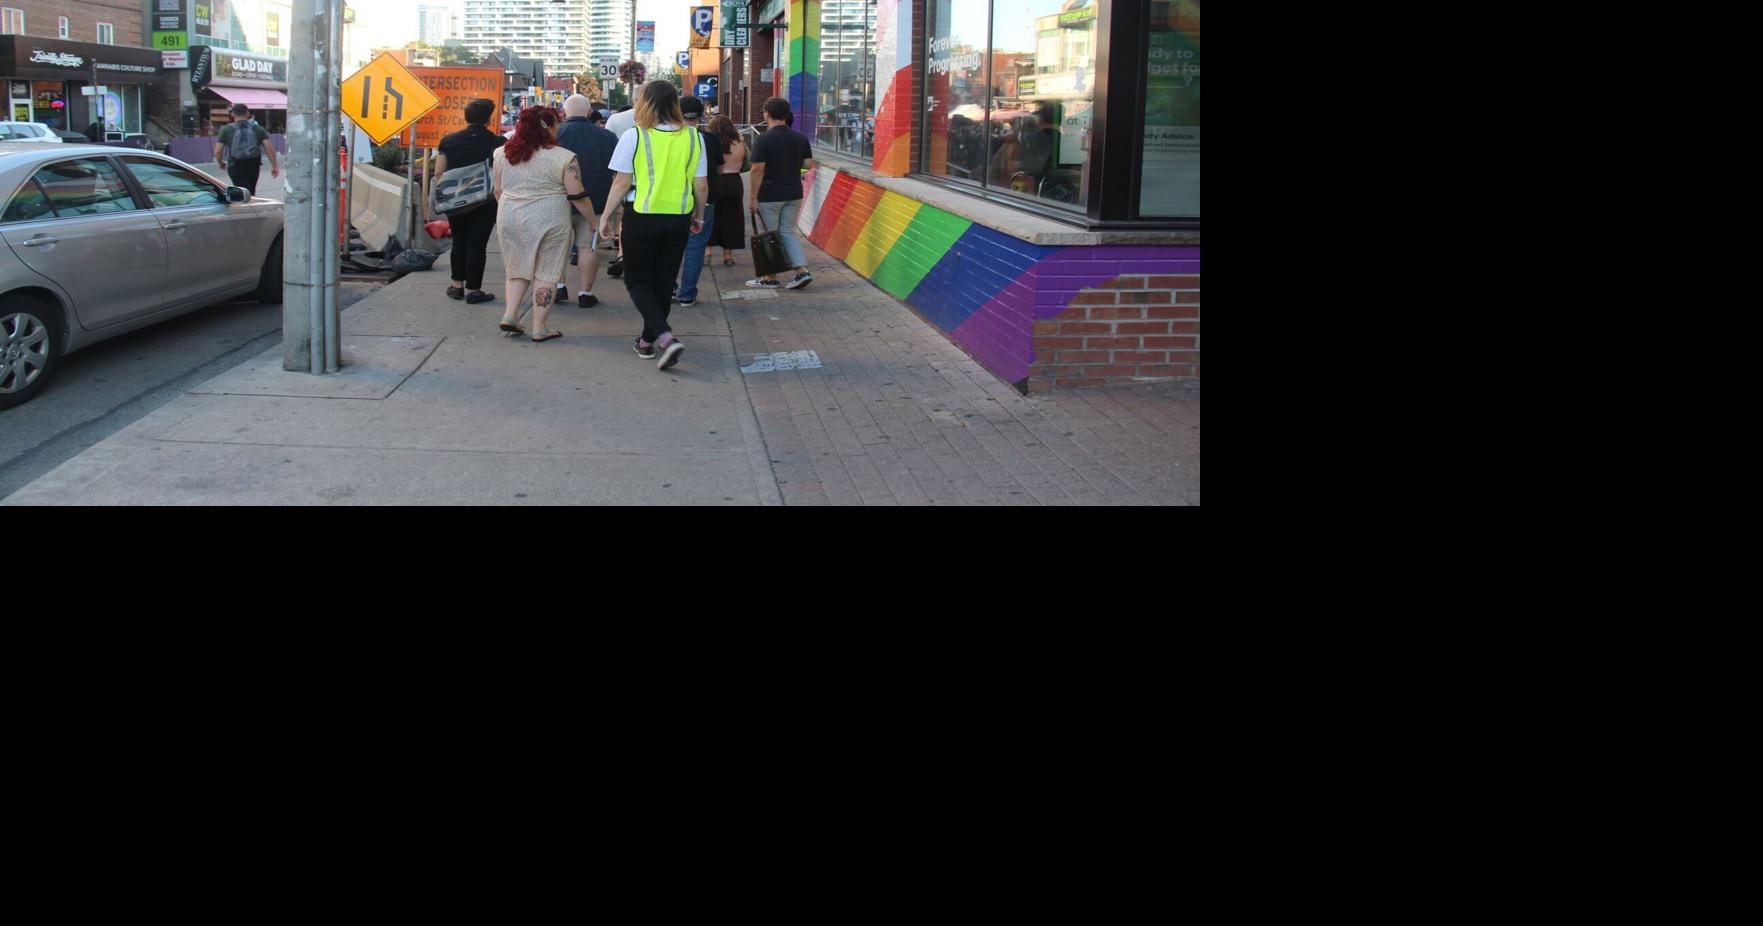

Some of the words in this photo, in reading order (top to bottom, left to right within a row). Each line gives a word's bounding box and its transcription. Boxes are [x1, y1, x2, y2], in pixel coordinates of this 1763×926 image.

[196, 4, 208, 18] CW
[696, 9, 712, 29] P
[160, 35, 180, 46] 491
[724, 29, 735, 45] DRY
[1175, 49, 1193, 59] to
[120, 64, 142, 72] CULTURE
[231, 57, 256, 71] GLAD
[256, 60, 273, 74] DAY
[928, 51, 981, 76] Progressing.
[601, 65, 617, 76] 30
[421, 76, 496, 91] TERSECTION
[699, 84, 710, 94] P
[415, 131, 439, 143] ugust
[1160, 132, 1194, 140] Advice
